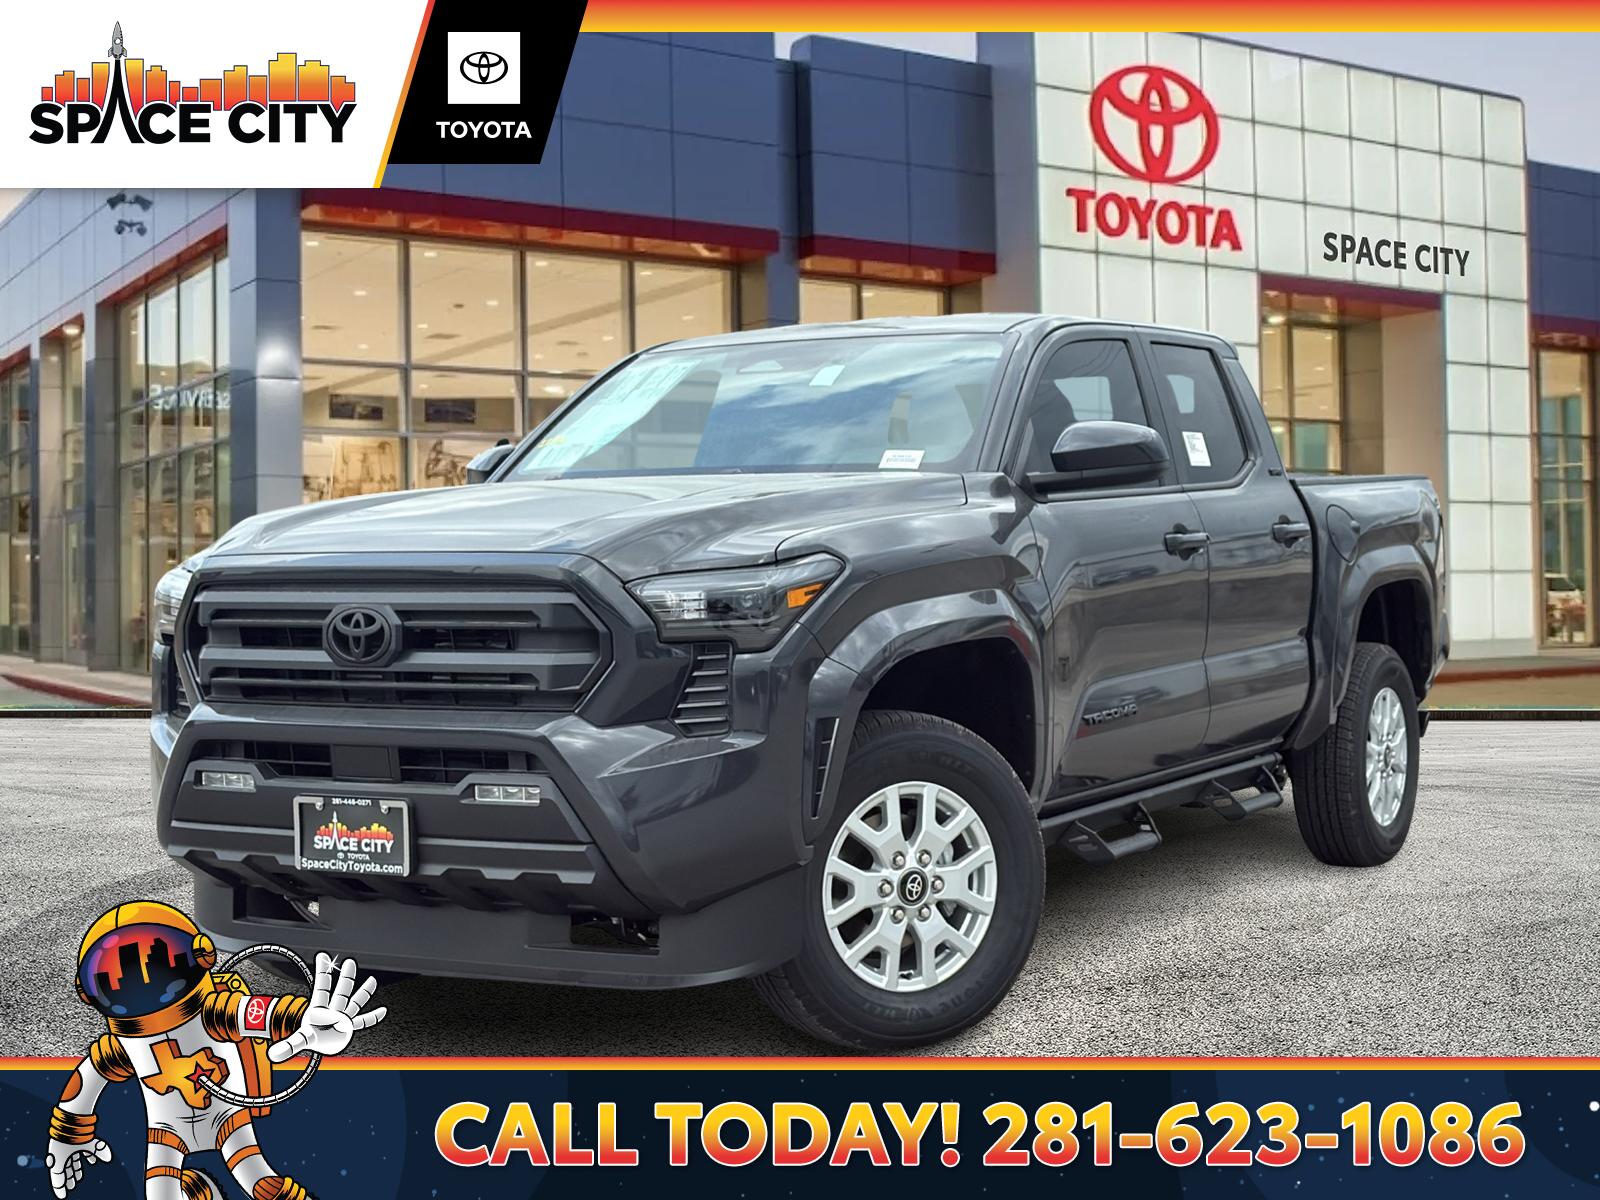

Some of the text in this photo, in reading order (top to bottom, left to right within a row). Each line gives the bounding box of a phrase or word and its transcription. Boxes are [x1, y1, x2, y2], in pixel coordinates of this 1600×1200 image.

[1066, 187, 1242, 251] TOYOTA
[1323, 232, 1470, 277] SPACE CITY
[313, 830, 394, 853] SPACE CITY
[301, 858, 403, 874] SpaceCityToyota.com
